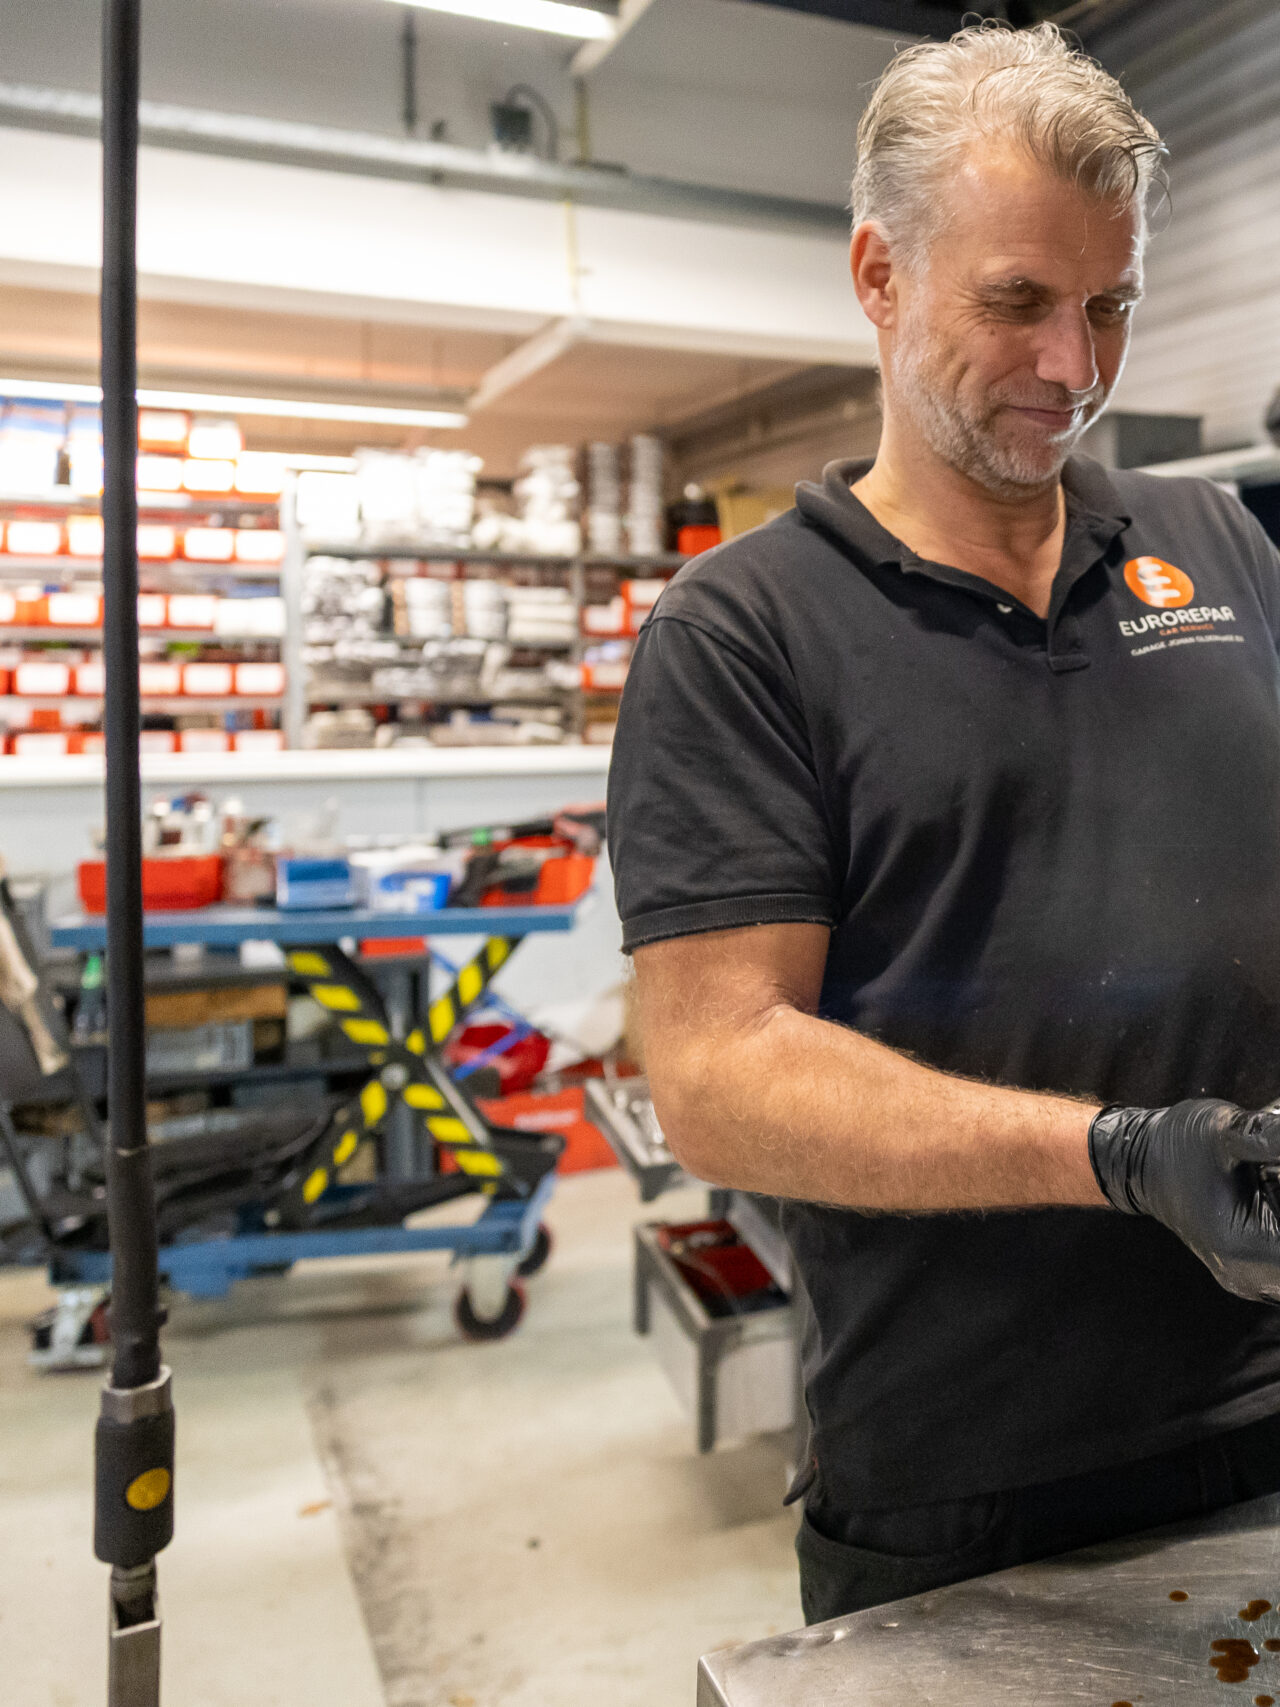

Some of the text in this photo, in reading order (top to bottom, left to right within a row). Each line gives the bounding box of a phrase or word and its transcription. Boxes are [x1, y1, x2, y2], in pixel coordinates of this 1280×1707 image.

[1118, 605, 1236, 636] EUROREPAR
[1159, 627, 1178, 636] CAR
[1130, 641, 1167, 656] GARAGE
